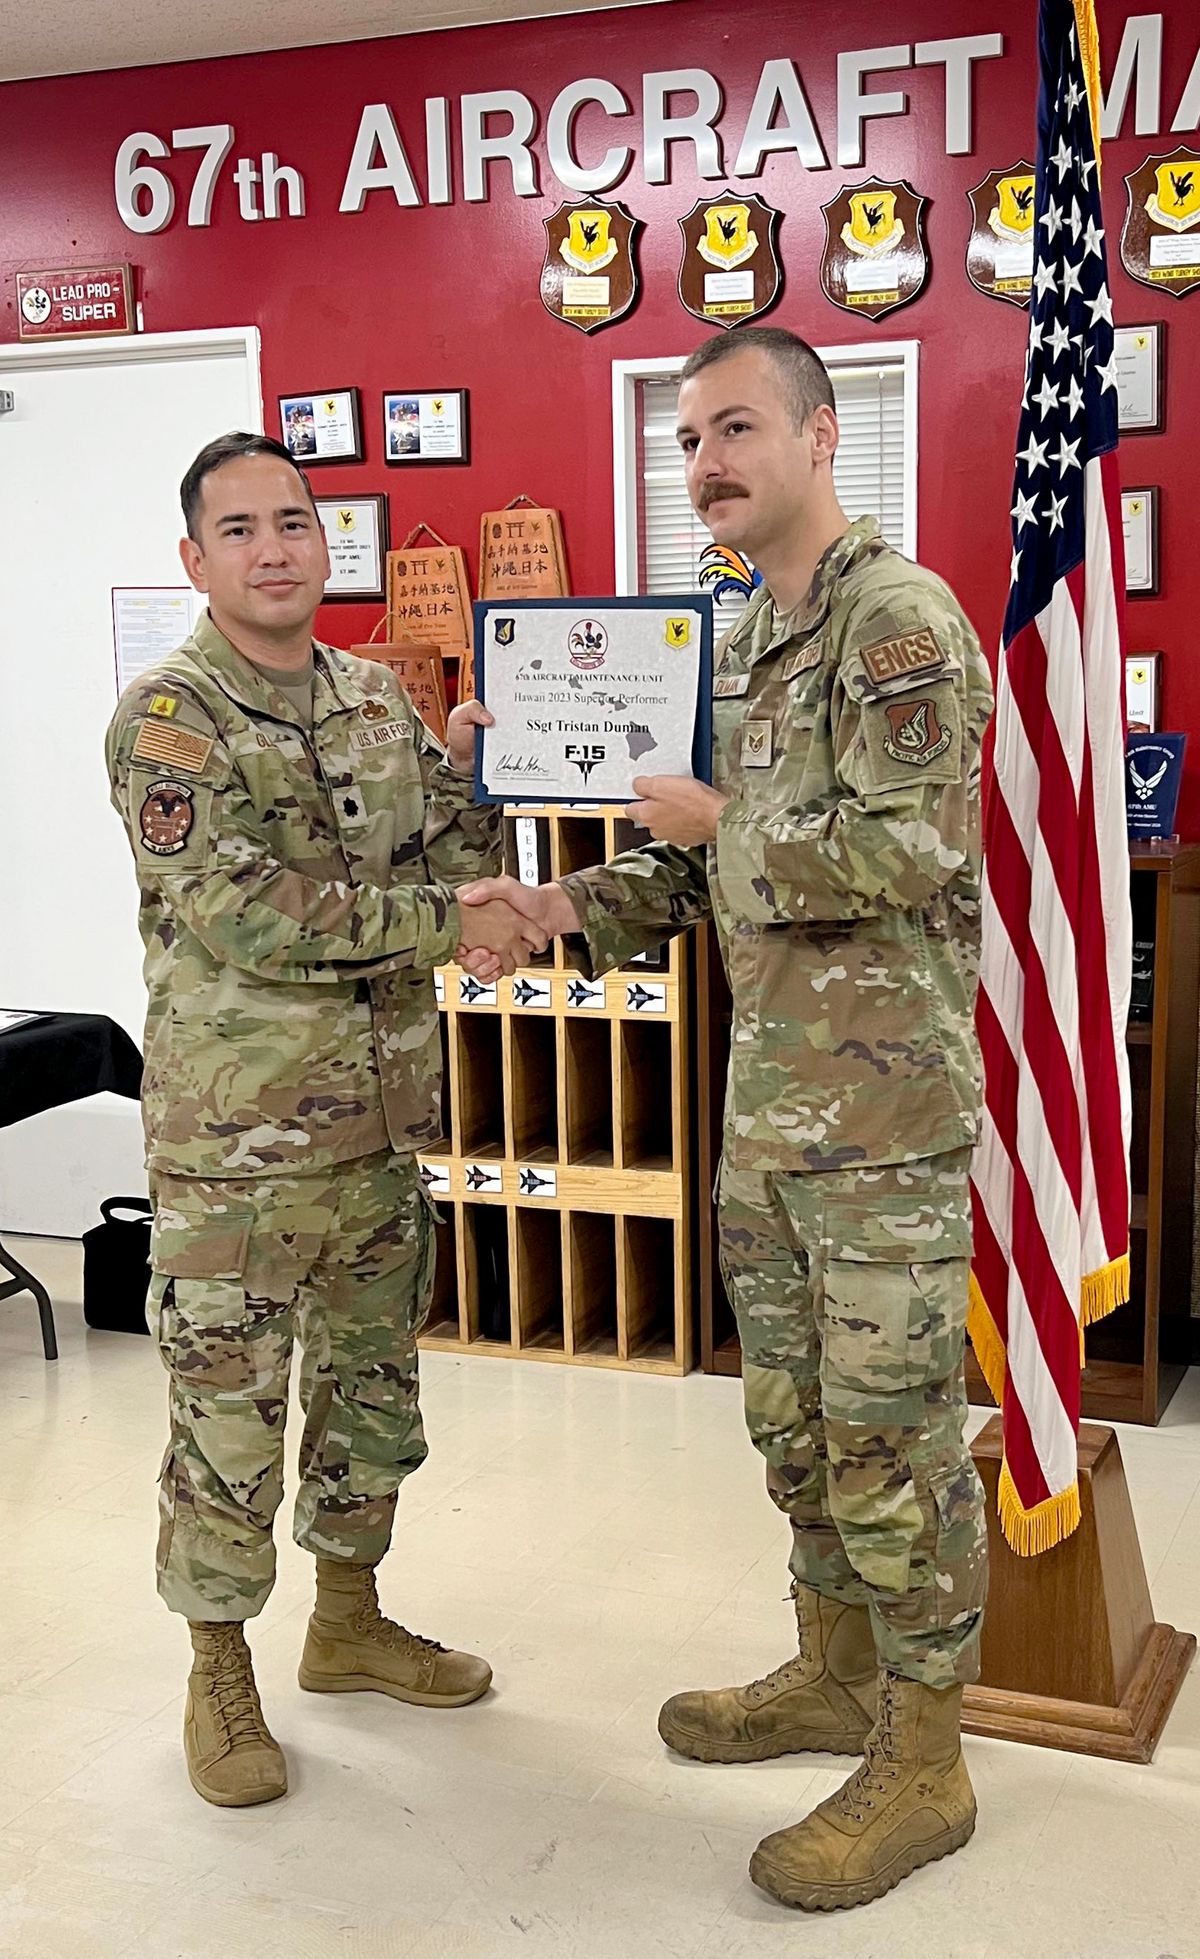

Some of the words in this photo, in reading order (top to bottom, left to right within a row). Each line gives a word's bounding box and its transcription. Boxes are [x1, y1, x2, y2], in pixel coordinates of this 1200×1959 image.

[115, 124, 305, 234] 67th
[338, 32, 1003, 213] AIRCRAFT
[52, 284, 84, 302] LEAD
[62, 302, 117, 322] SUPER
[866, 634, 938, 678] ENGS
[532, 673, 575, 681] AIRCRAFT
[576, 674, 640, 682] MAINTENANCE
[642, 674, 664, 682] UNIT
[514, 692, 546, 703] Hawaii
[548, 692, 571, 703] 2023
[574, 693, 616, 705] Superior
[618, 693, 668, 705] Performer
[373, 725, 392, 745] AIR
[526, 719, 552, 734] SSgt
[557, 719, 599, 733] Tristan
[604, 720, 650, 734] Duman
